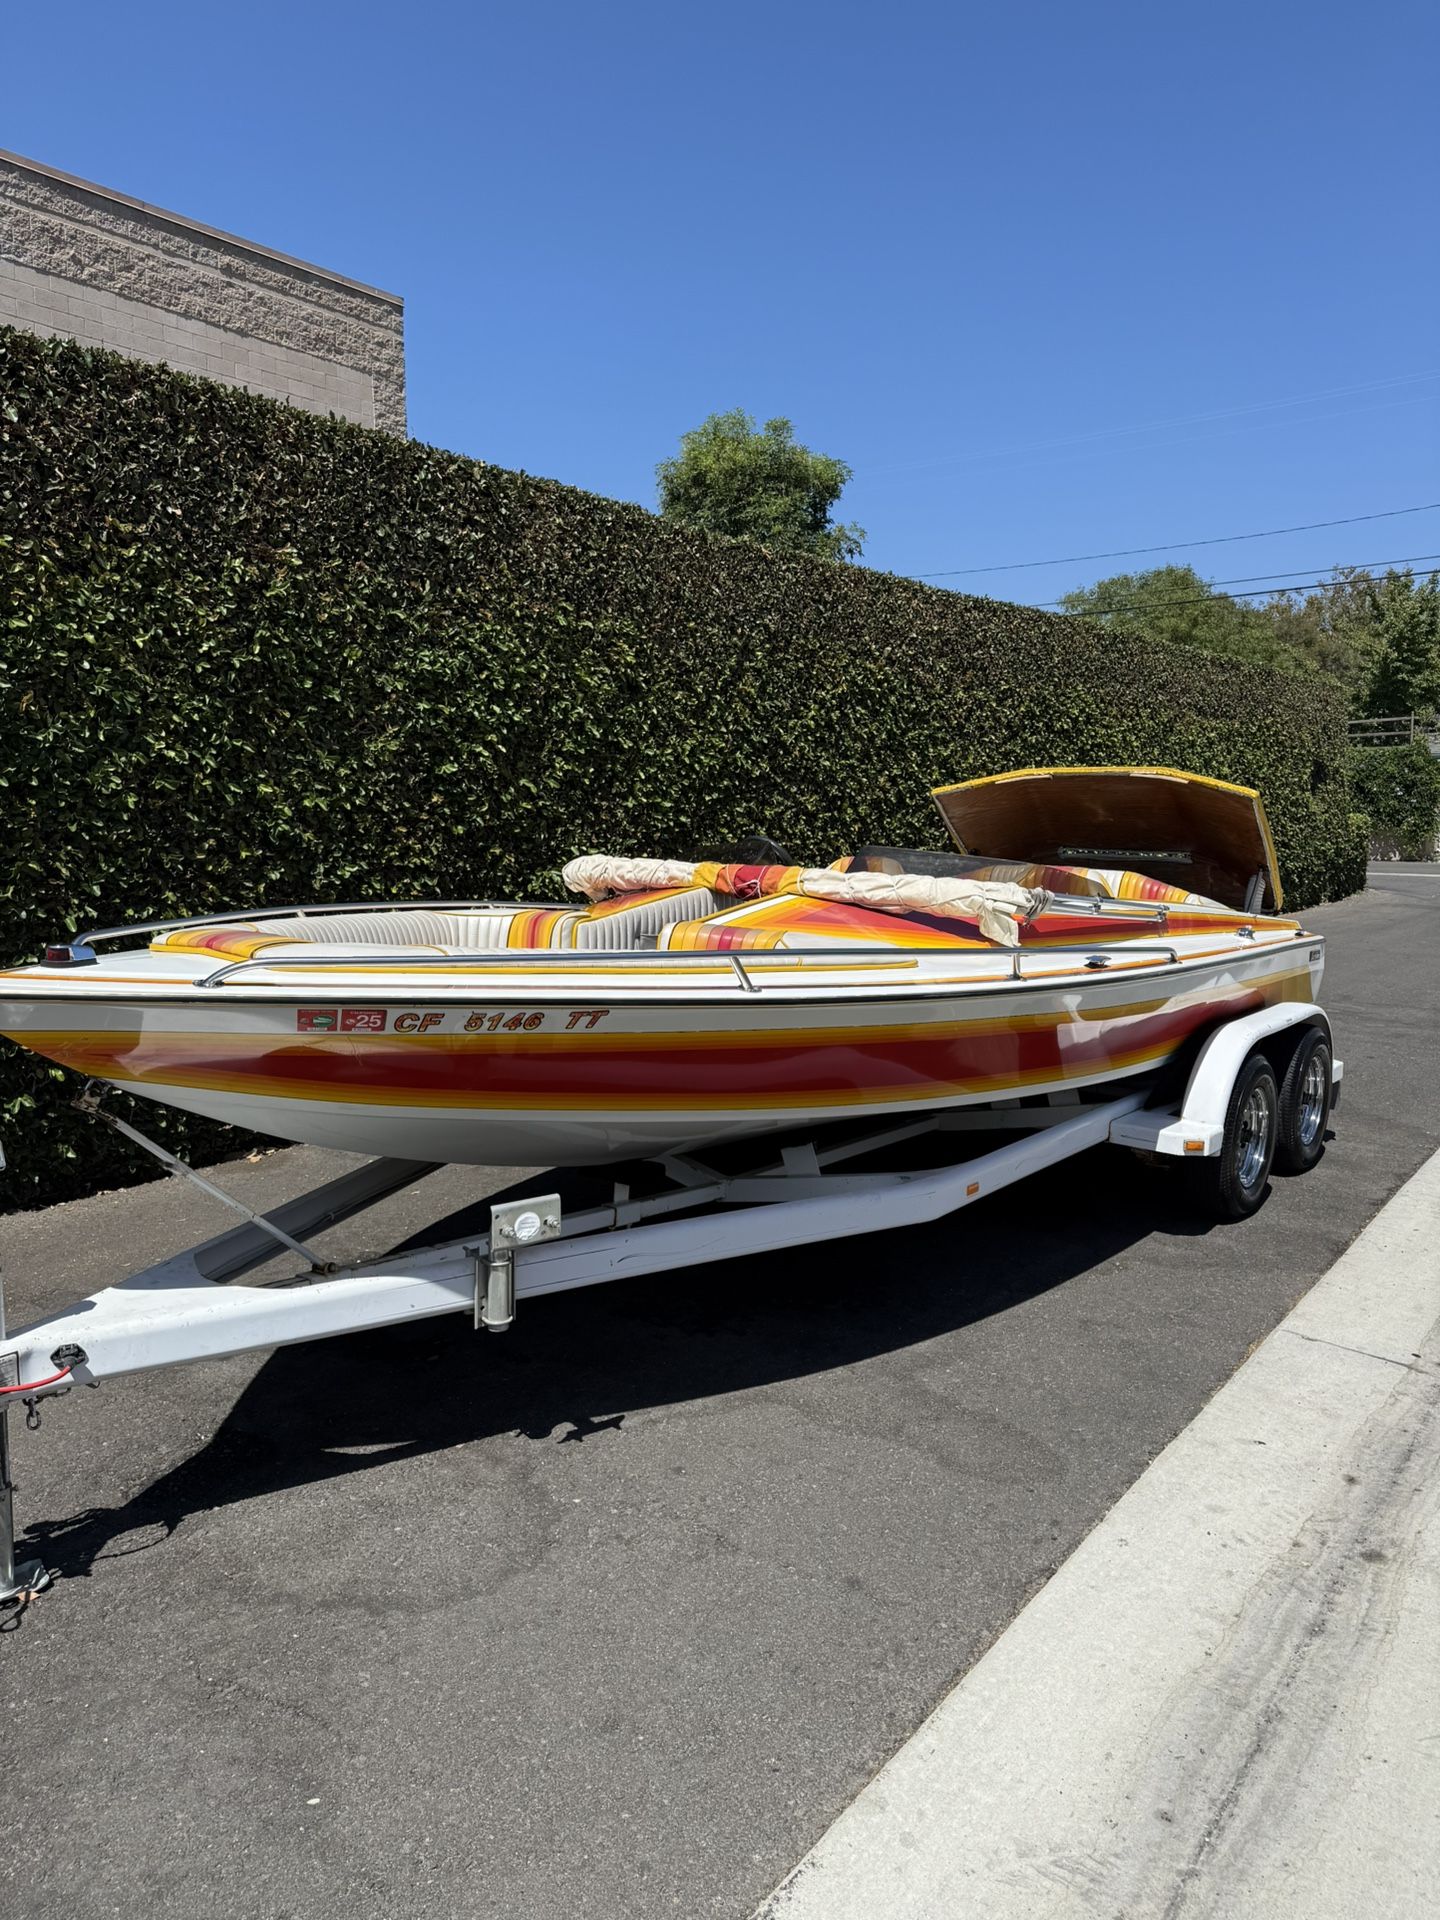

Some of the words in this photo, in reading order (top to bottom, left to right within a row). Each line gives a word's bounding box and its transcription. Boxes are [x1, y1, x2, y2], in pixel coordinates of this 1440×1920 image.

[355, 1015, 382, 1027] 25
[394, 1013, 445, 1032] CF
[464, 1011, 545, 1031] 5146
[565, 1010, 610, 1029] TT
